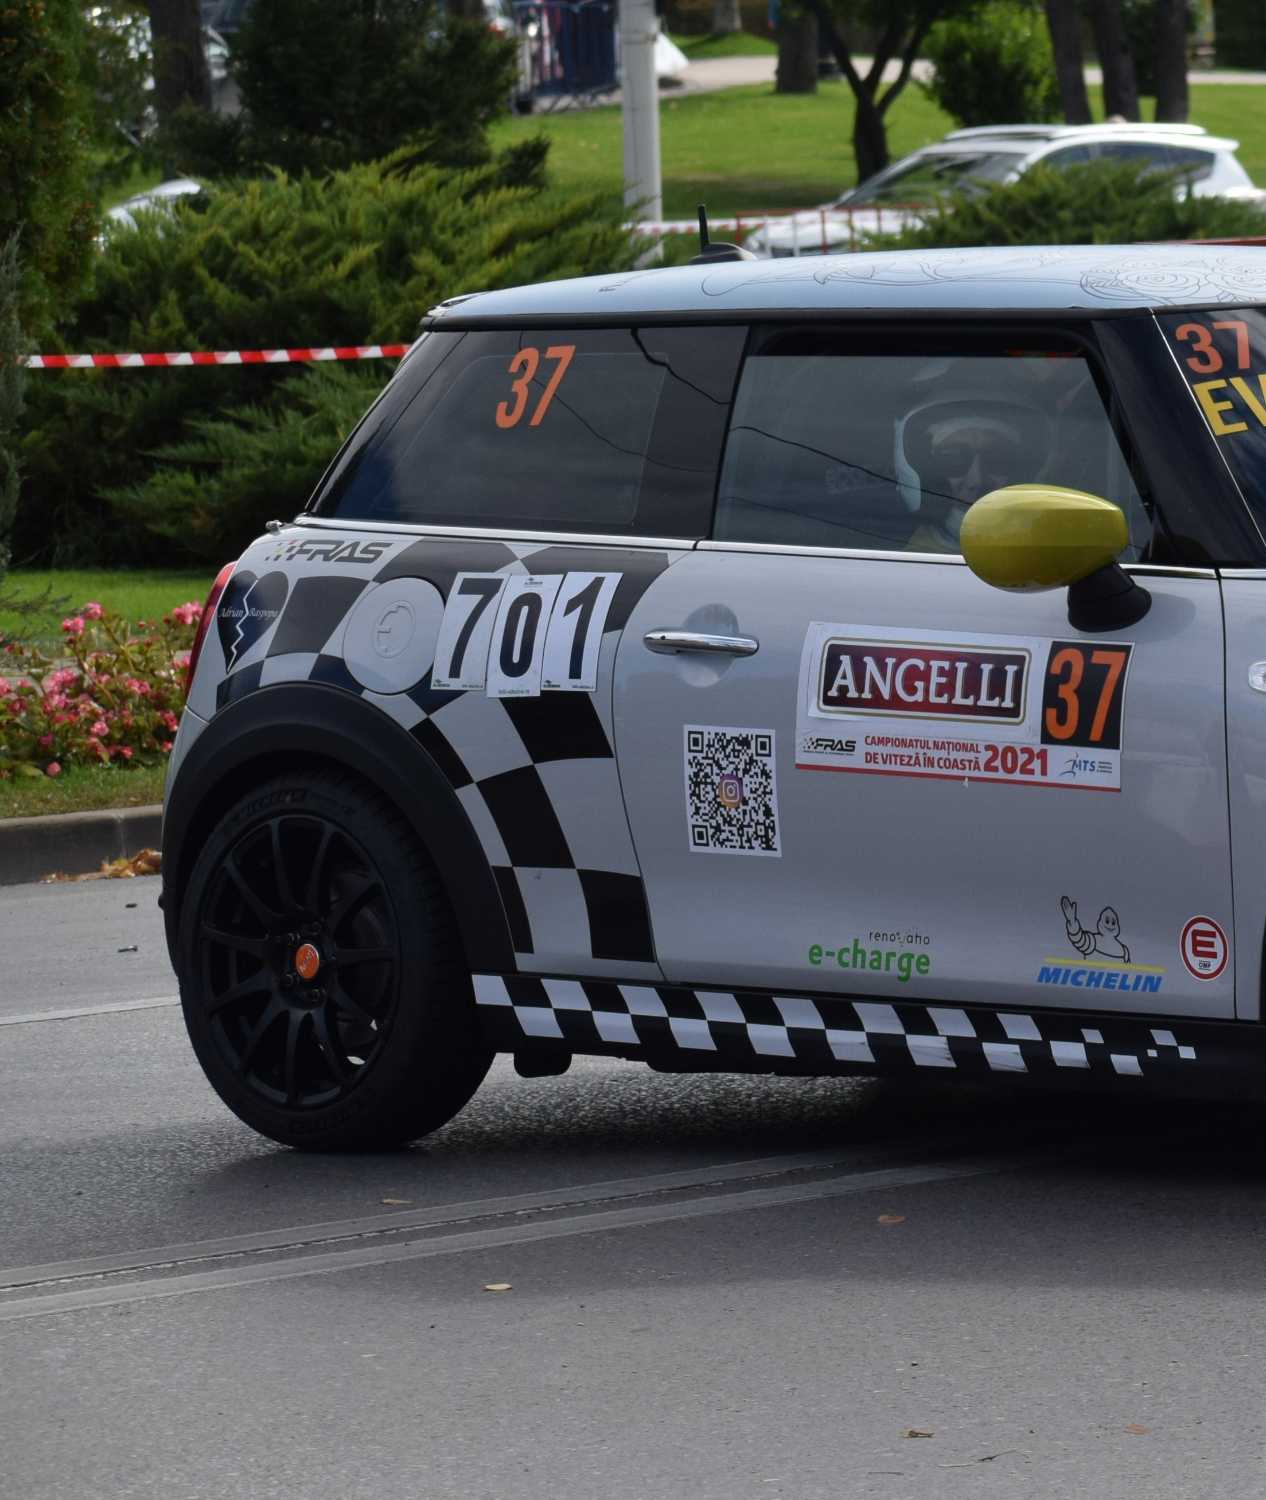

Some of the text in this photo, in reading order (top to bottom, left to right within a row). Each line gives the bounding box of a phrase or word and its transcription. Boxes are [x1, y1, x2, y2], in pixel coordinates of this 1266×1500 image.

[1175, 321, 1253, 374] 37
[496, 345, 576, 428] 37
[448, 576, 606, 682] 701
[827, 655, 1019, 708] ANGELLI
[1045, 647, 1127, 742] 37
[813, 738, 857, 752] FRAS
[864, 736, 931, 750] CAMPIONATUL
[865, 752, 982, 772] DE VITEZĂ ÎN COASTĂ
[983, 744, 1048, 776] 2021
[808, 937, 931, 983] e-charge
[1037, 966, 1163, 993] MICHELIN
